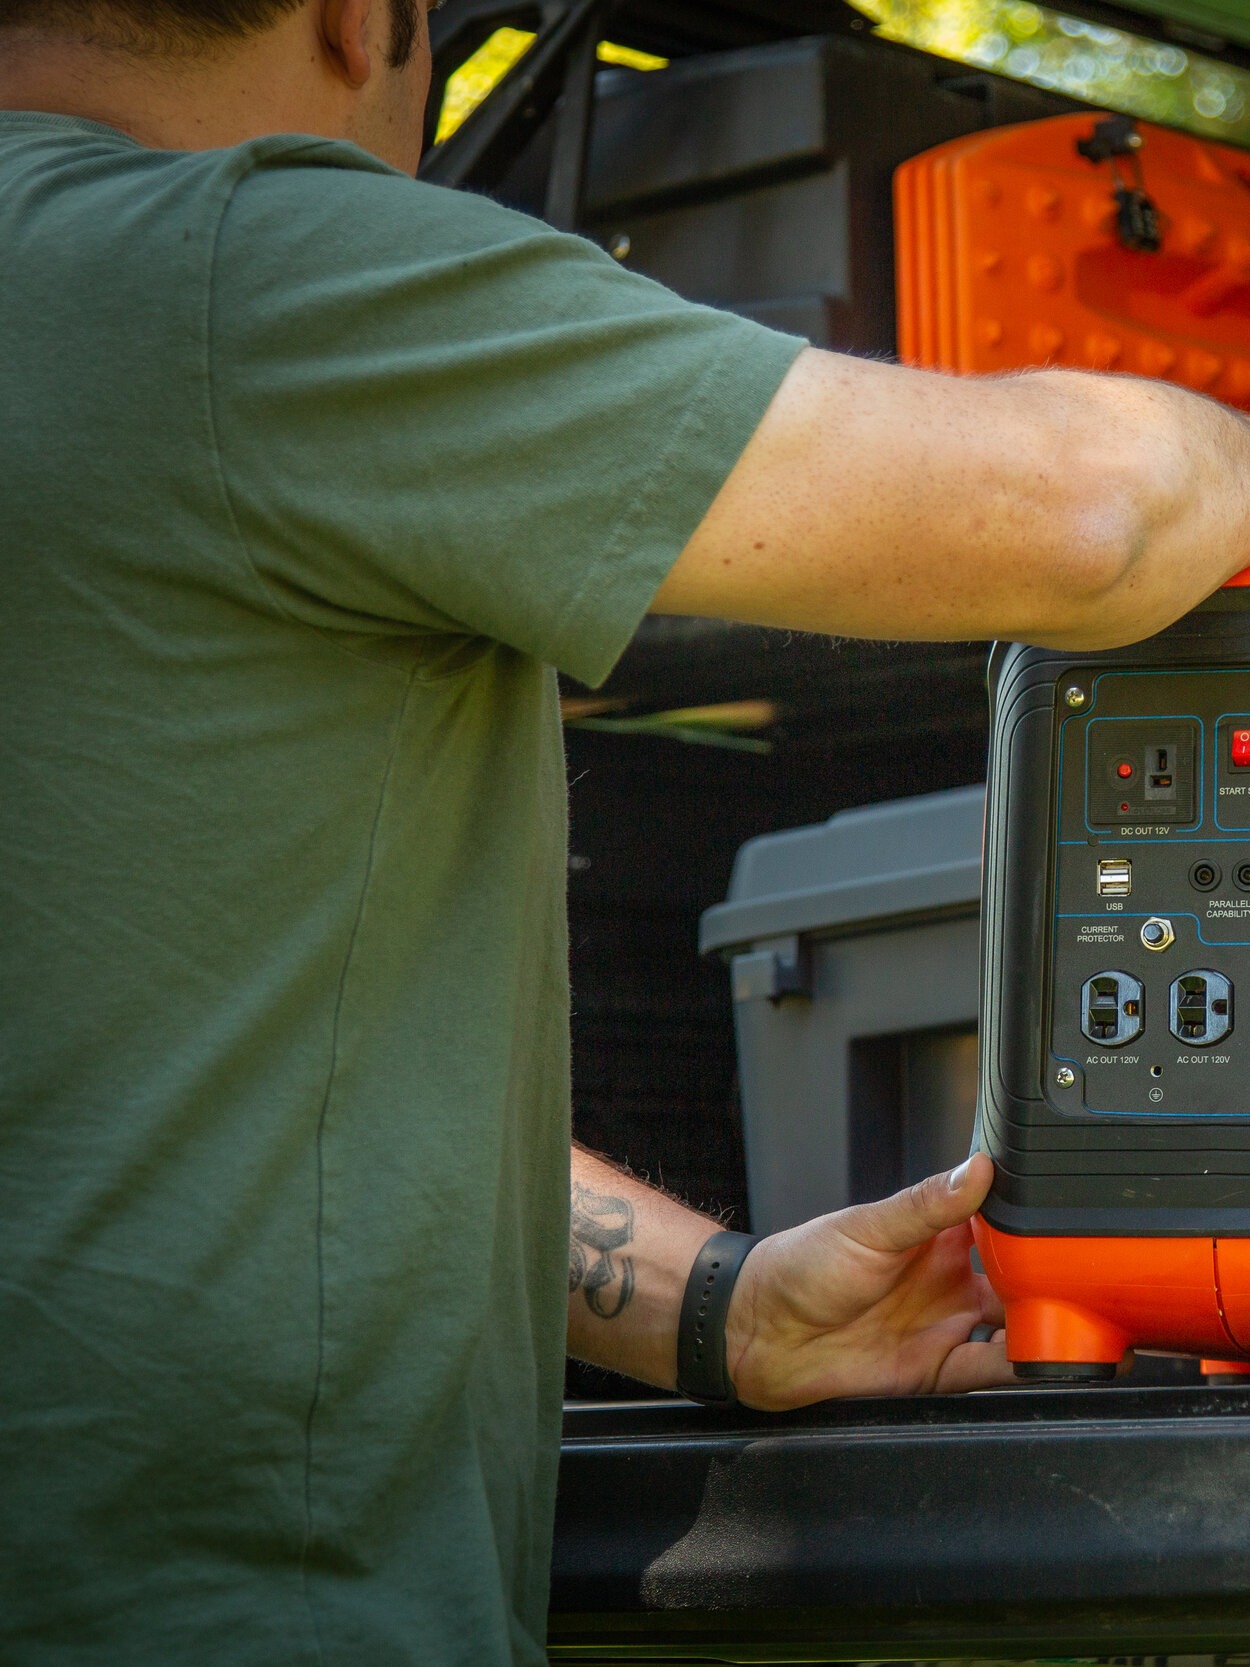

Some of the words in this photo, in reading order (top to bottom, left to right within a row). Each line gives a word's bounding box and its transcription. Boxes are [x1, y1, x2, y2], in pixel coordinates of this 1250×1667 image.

[1219, 786, 1246, 796] START
[1120, 827, 1135, 836] DC
[1136, 826, 1153, 835] OUT
[1155, 826, 1170, 835] 12V
[1106, 902, 1124, 911] USB
[1209, 900, 1250, 909] PARALLEL
[1081, 925, 1119, 935] CURRENT
[1076, 934, 1125, 943] PROTECTOR
[1086, 1056, 1099, 1064] AC
[1099, 1055, 1118, 1064] OUT
[1120, 1055, 1140, 1064] 120V
[1176, 1055, 1189, 1064] AC
[1190, 1055, 1209, 1064] OUT
[1211, 1055, 1231, 1064] 120V
